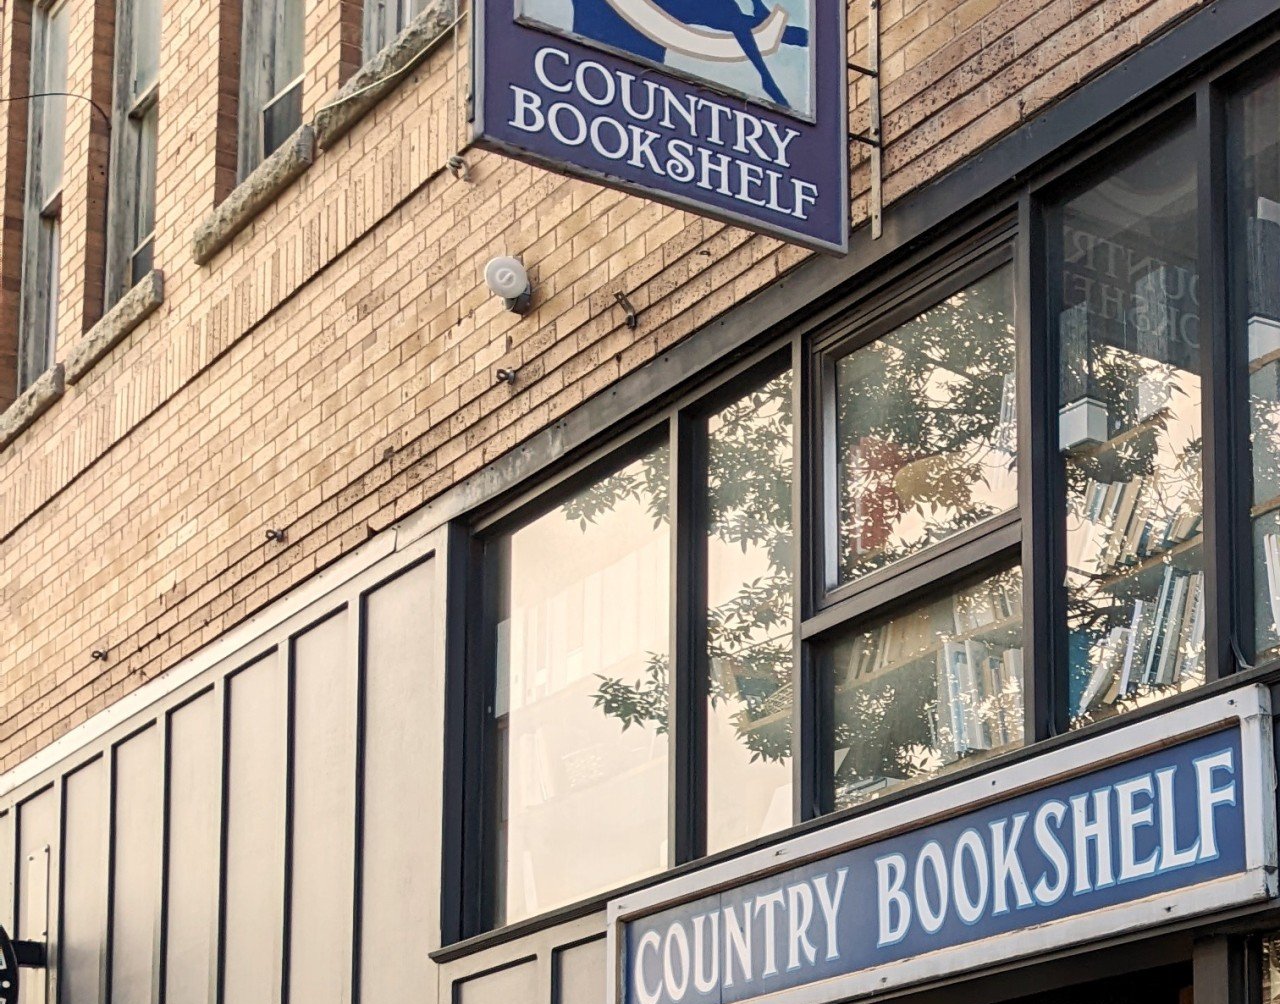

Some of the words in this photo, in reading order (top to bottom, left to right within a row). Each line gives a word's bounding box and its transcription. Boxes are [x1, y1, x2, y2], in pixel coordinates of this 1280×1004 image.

[508, 85, 819, 220] BOOKSHELF
[534, 46, 802, 168] COUNTRY
[874, 747, 1238, 948] BOOKSHELF
